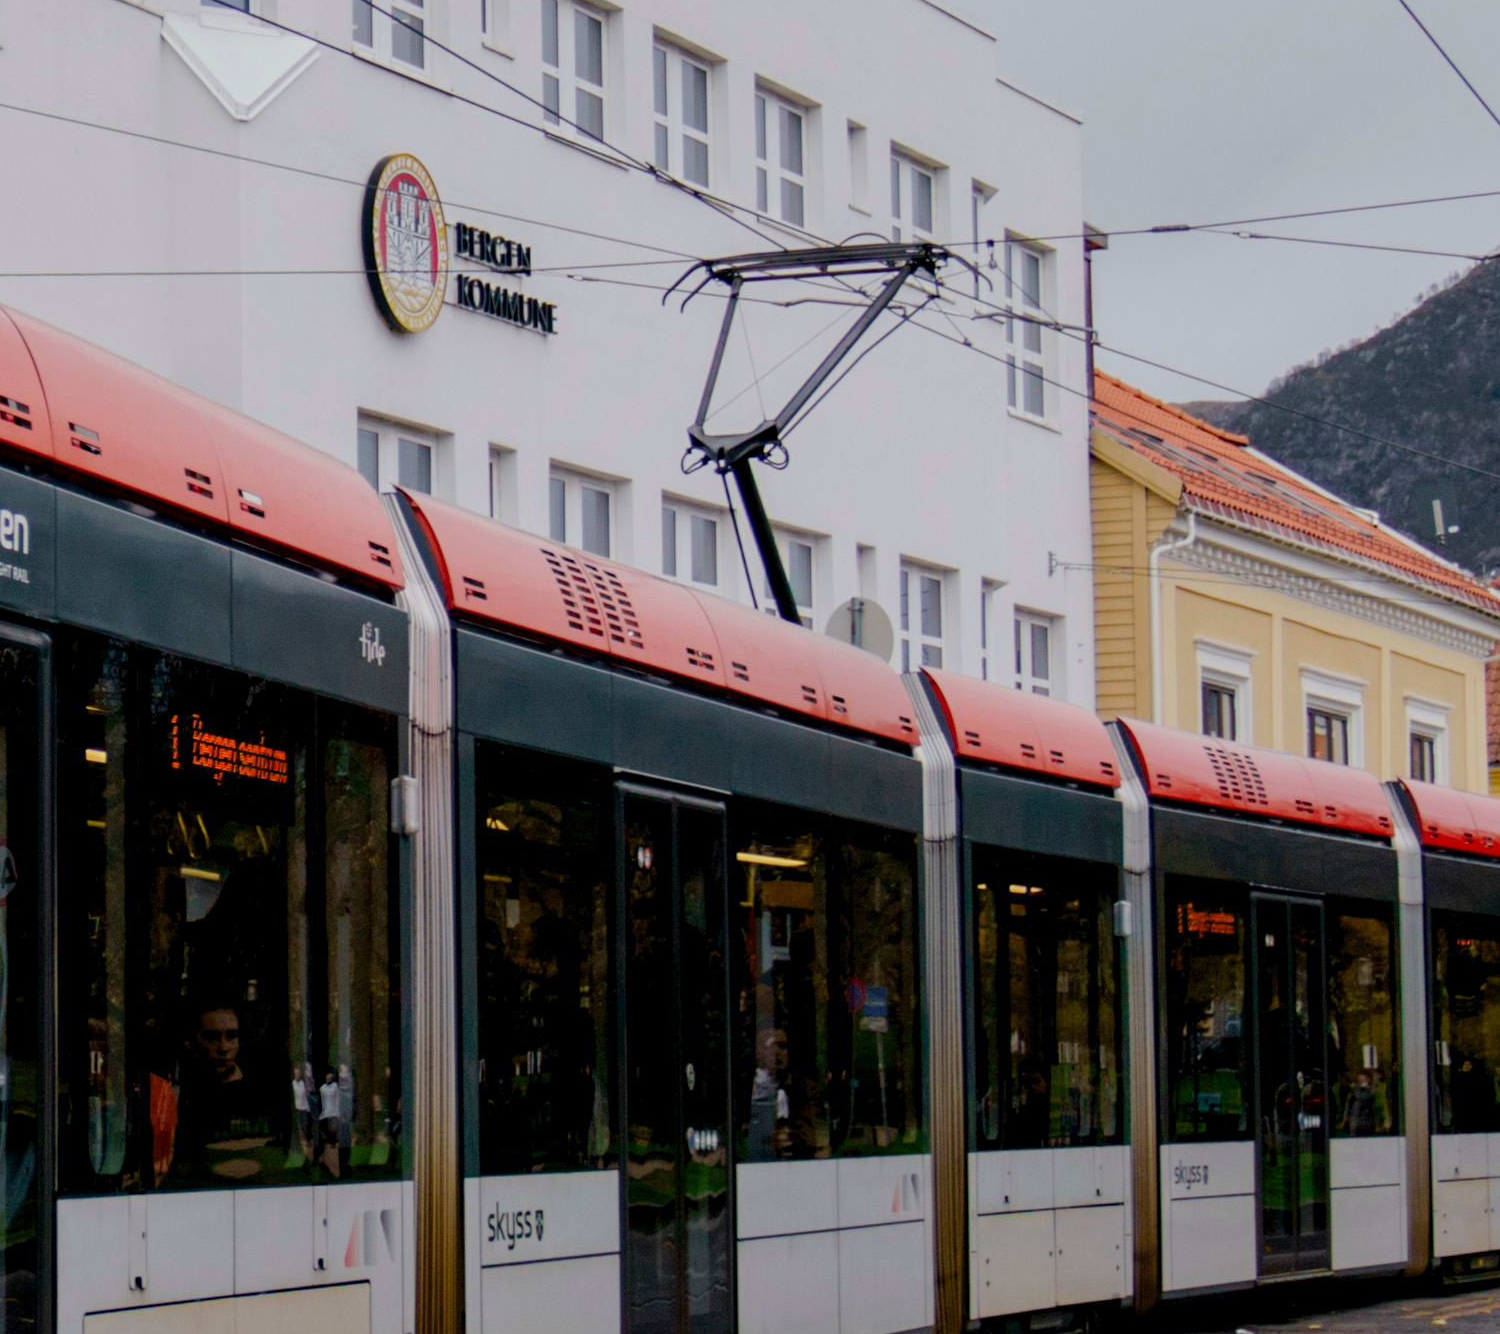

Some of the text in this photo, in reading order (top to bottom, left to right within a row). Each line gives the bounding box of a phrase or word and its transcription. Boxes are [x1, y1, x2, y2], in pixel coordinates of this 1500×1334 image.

[456, 222, 531, 272] BERGEN
[457, 274, 557, 335] KOMMUNE
[13, 567, 30, 584] RAIL
[1174, 1159, 1202, 1190] skyss
[487, 1201, 533, 1251] skyss
